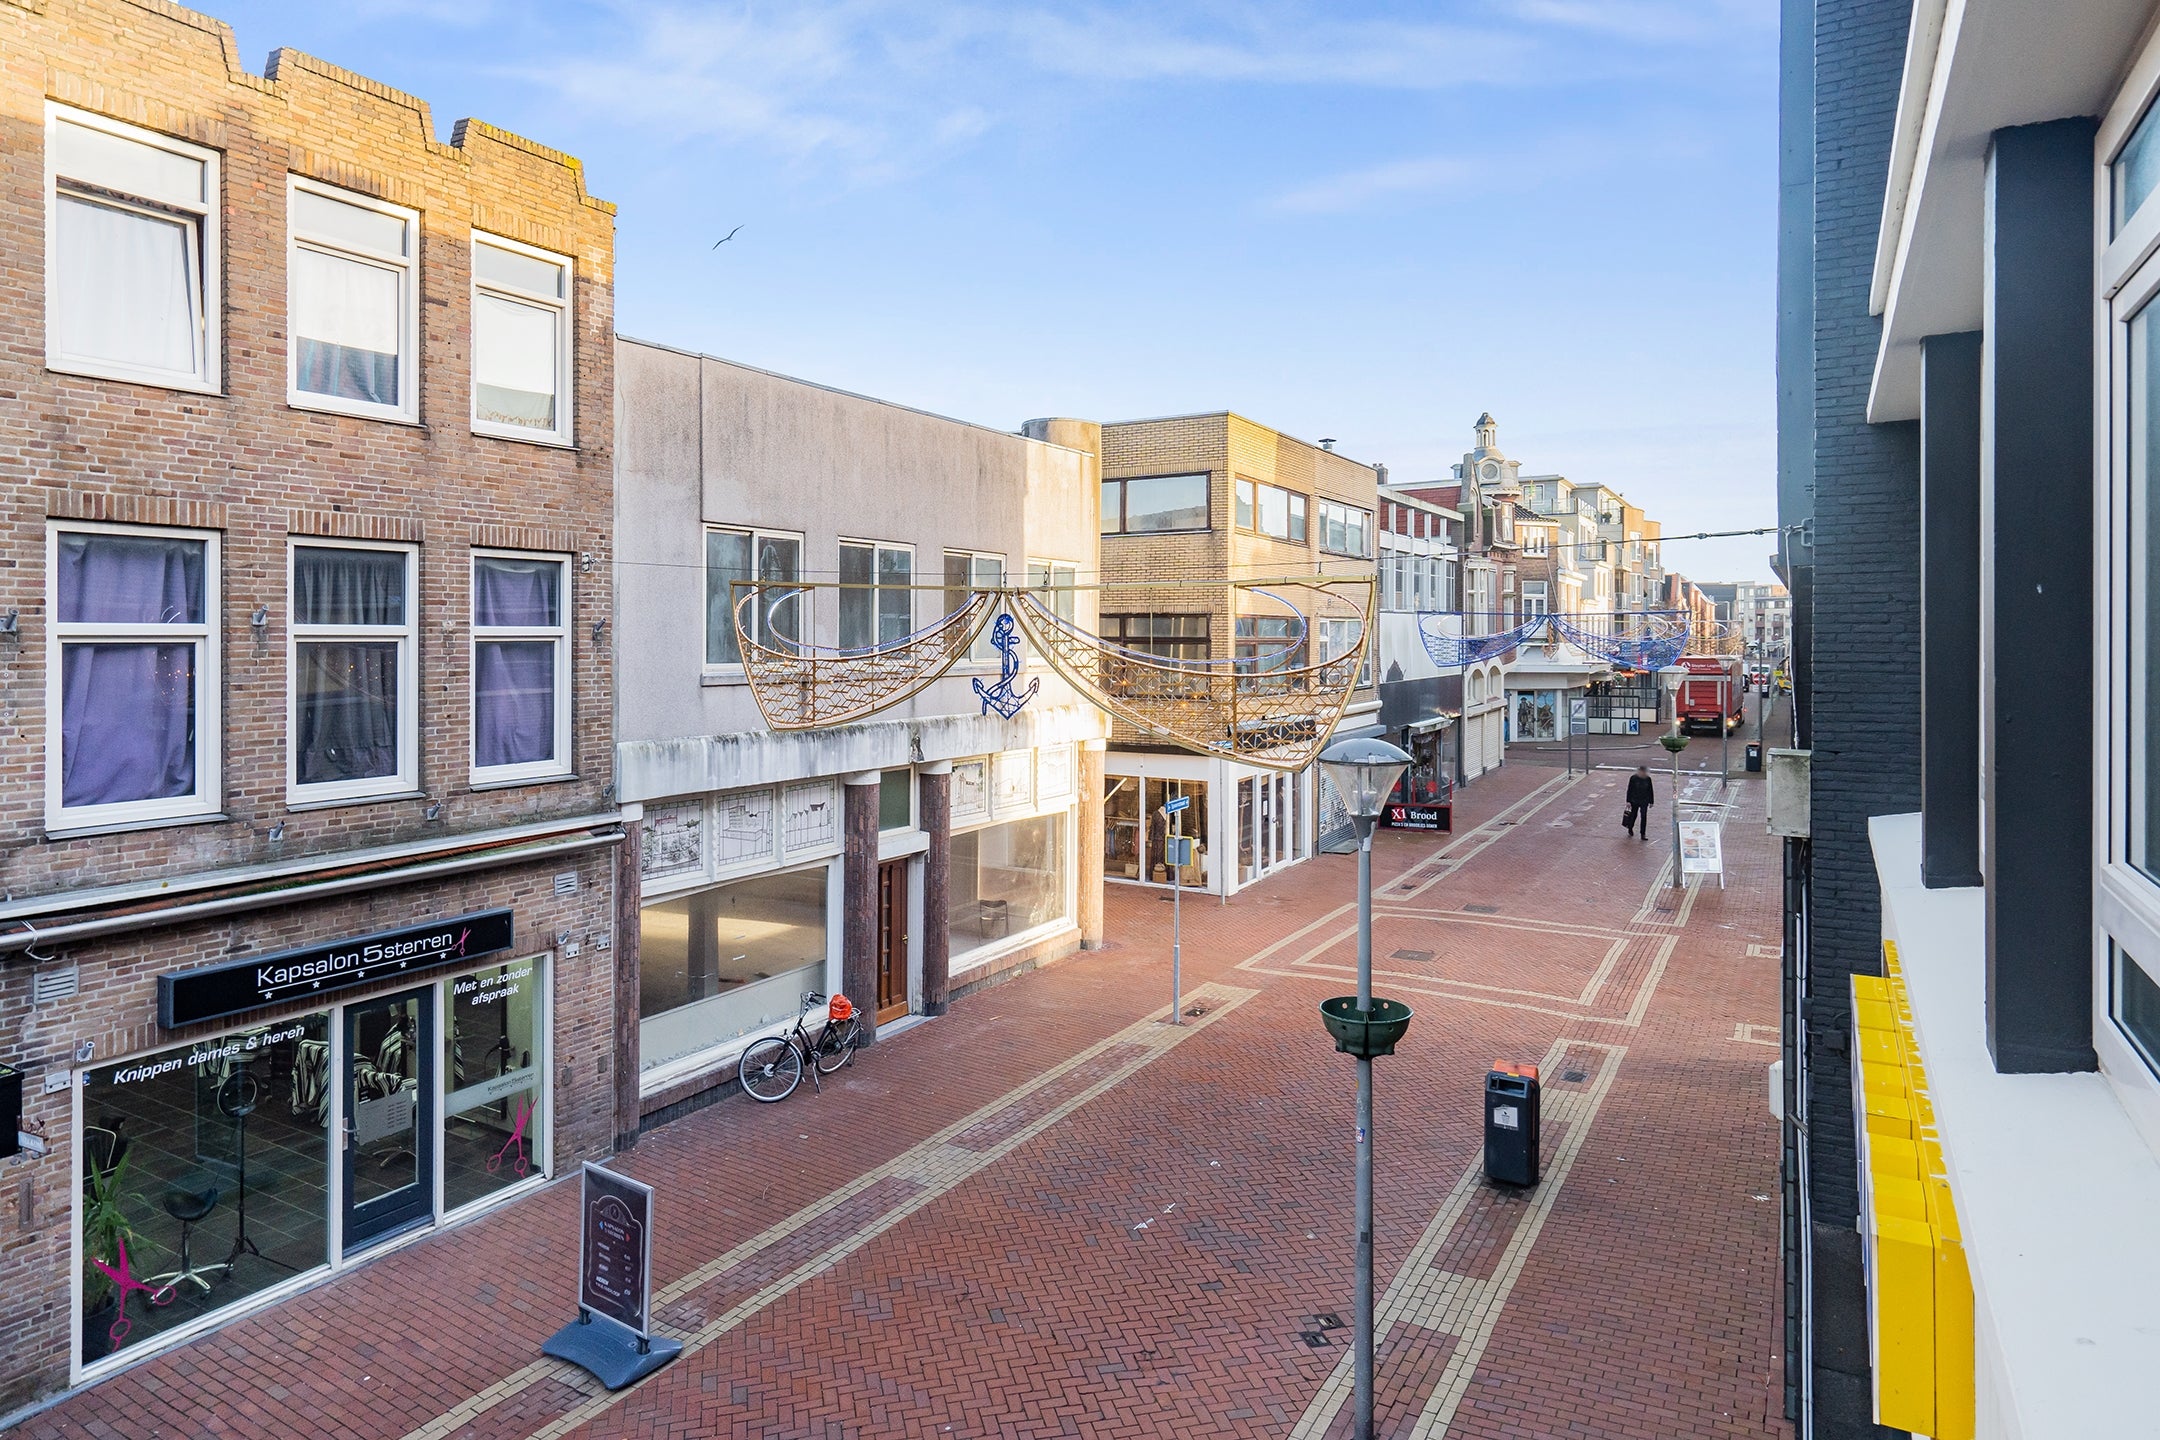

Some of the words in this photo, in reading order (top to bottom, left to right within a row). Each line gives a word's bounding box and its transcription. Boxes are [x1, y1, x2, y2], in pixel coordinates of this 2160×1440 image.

[1391, 808, 1407, 820] X1
[1410, 811, 1437, 820] Brood
[257, 952, 359, 987] Kapsalon
[453, 980, 478, 995] Met
[480, 977, 494, 989] en
[496, 966, 533, 984] zonder
[471, 983, 520, 1006] afspraak
[113, 1058, 182, 1085] Knippen
[188, 1043, 240, 1066] dames
[245, 1036, 258, 1050] &
[262, 1026, 305, 1047] heren
